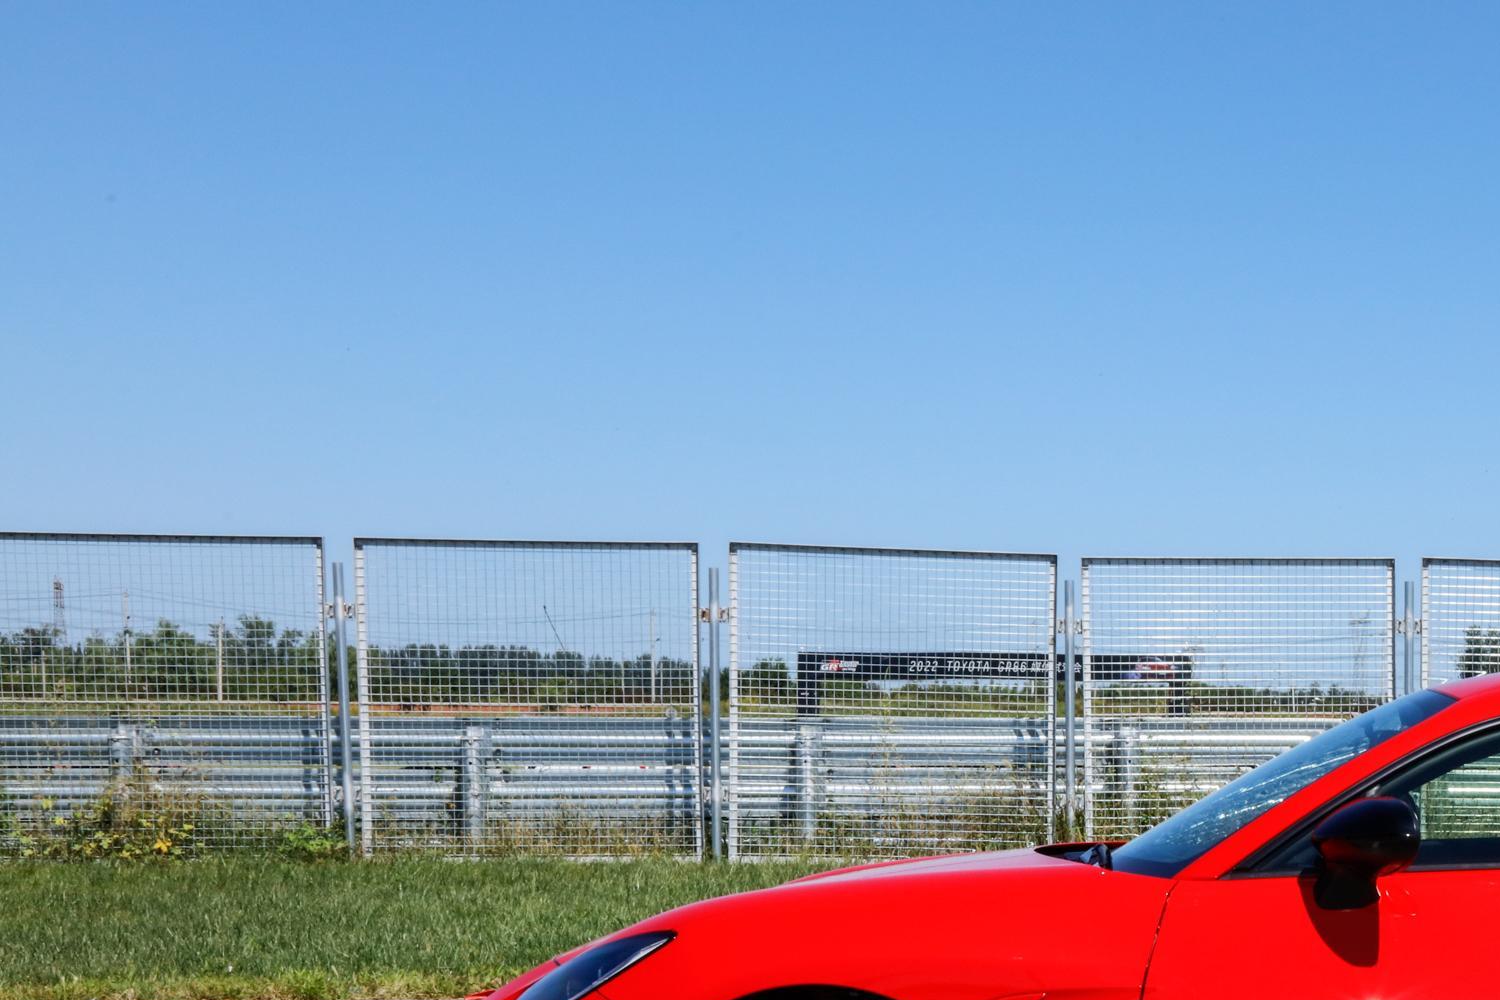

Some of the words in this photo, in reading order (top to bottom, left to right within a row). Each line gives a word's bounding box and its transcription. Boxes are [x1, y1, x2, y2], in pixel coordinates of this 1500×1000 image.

[909, 660, 938, 672] 2022
[946, 660, 991, 672] TOYOTA
[997, 660, 1027, 673] GR86
